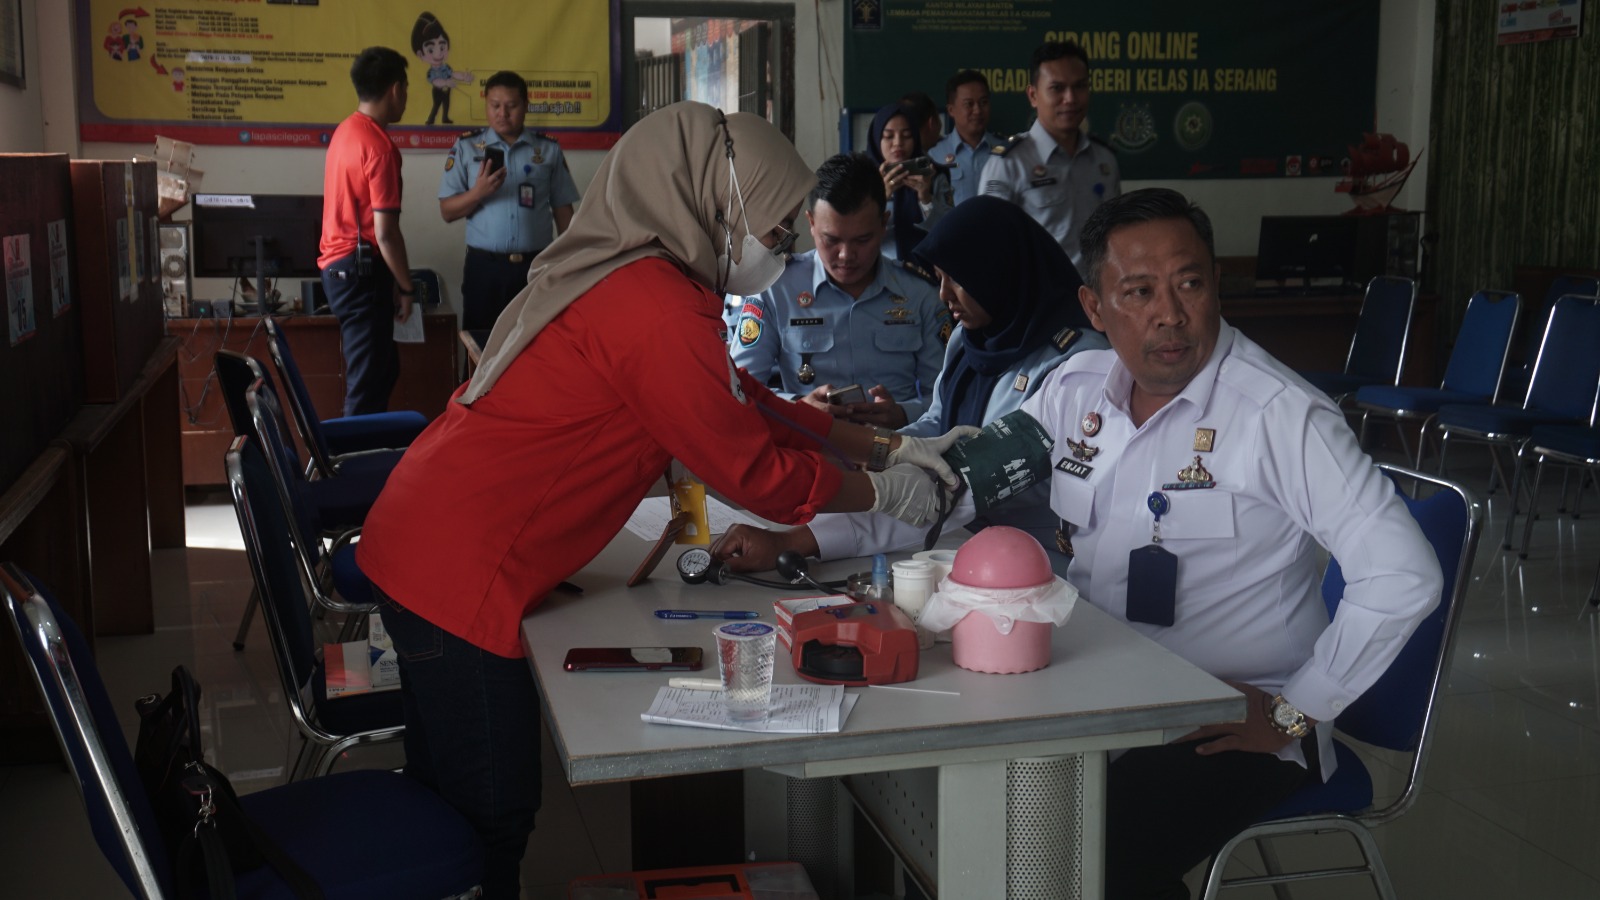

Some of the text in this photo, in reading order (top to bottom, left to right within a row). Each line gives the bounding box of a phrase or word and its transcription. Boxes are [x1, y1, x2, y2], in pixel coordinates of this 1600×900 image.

[955, 1, 985, 9] WILAYAH
[986, 1, 1014, 9] BANTEN
[886, 9, 920, 17] LEMBAGA
[1126, 31, 1199, 60] ONLINE
[1136, 68, 1188, 92] KELAS
[1193, 68, 1210, 92] IA
[1214, 68, 1277, 92] SERANG
[549, 102, 564, 116] saja
[1060, 460, 1089, 476] ENJAT
